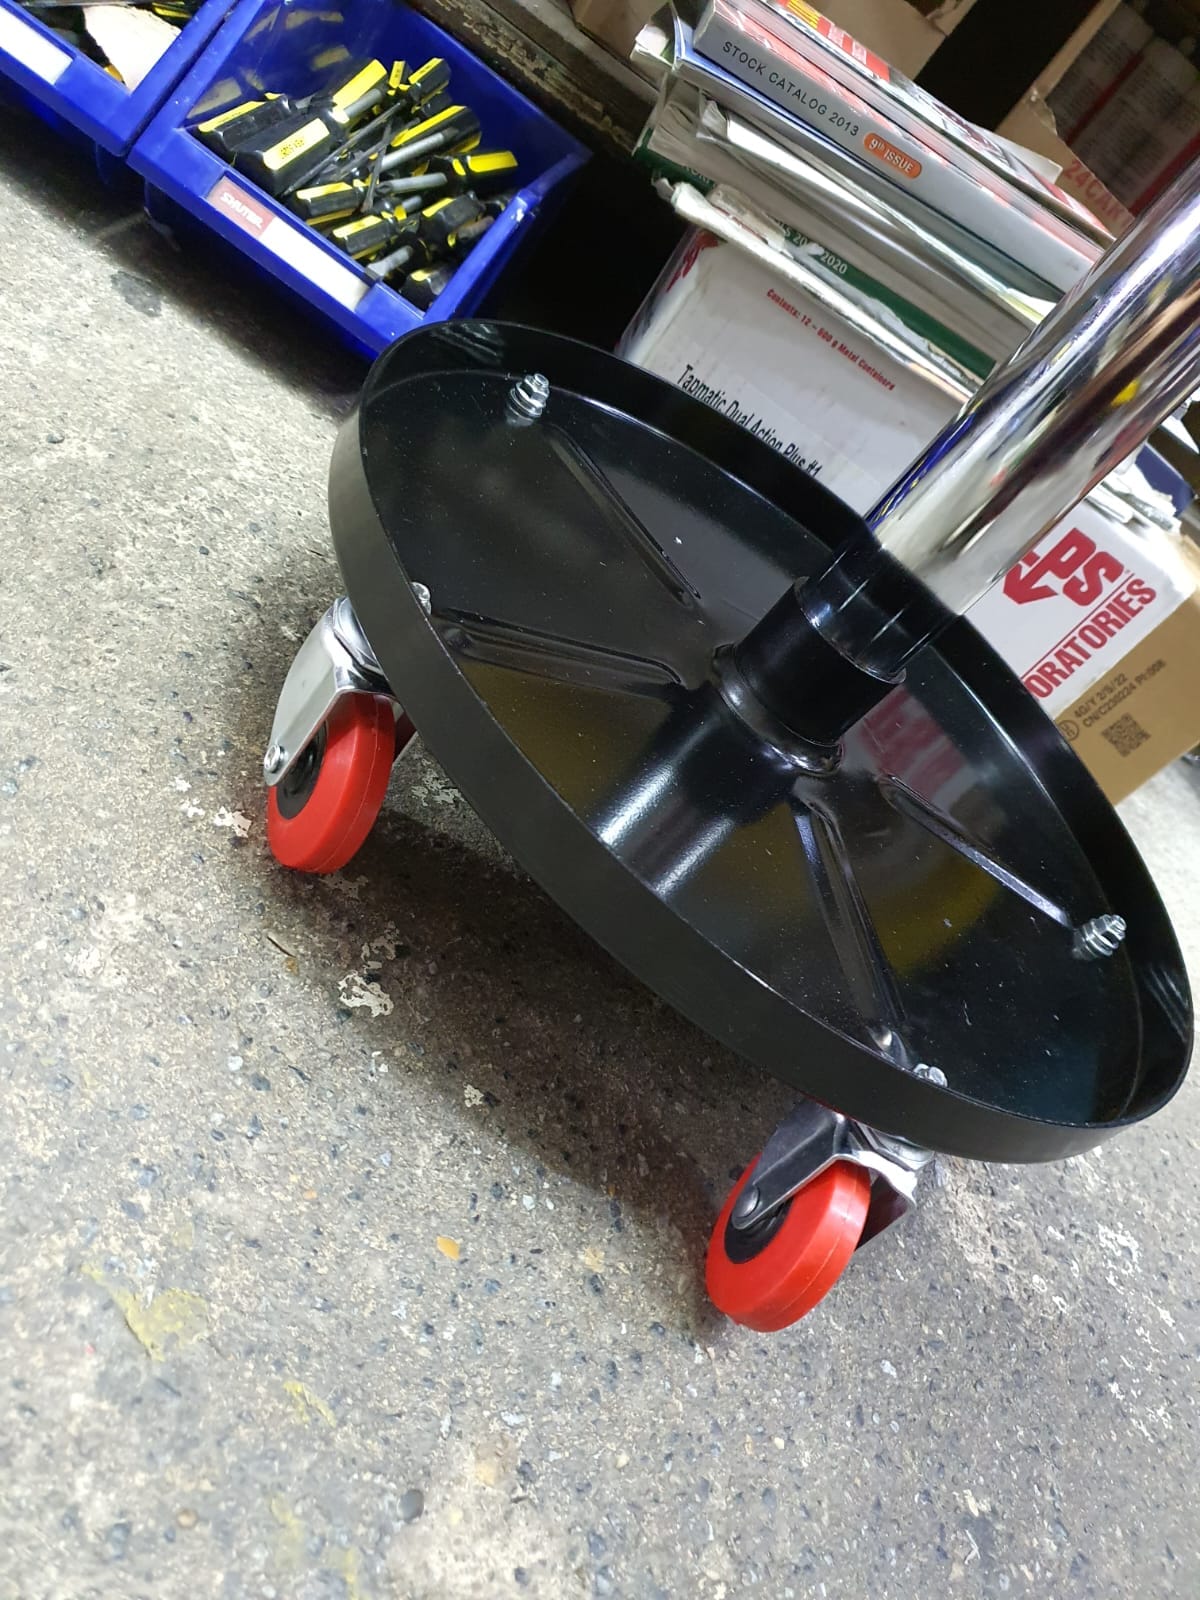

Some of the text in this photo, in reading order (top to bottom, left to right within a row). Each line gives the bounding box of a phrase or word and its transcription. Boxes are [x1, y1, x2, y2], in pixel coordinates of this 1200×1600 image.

[723, 41, 860, 137] STOCK CATALOG 2013
[883, 149, 914, 174] ISSUE
[820, 252, 848, 275] 2020
[801, 315, 812, 326] 12
[838, 343, 860, 362] Metal
[858, 359, 896, 391] Containers
[677, 363, 727, 411] Tapmatic
[725, 400, 754, 427] Dual
[750, 419, 784, 449] Action
